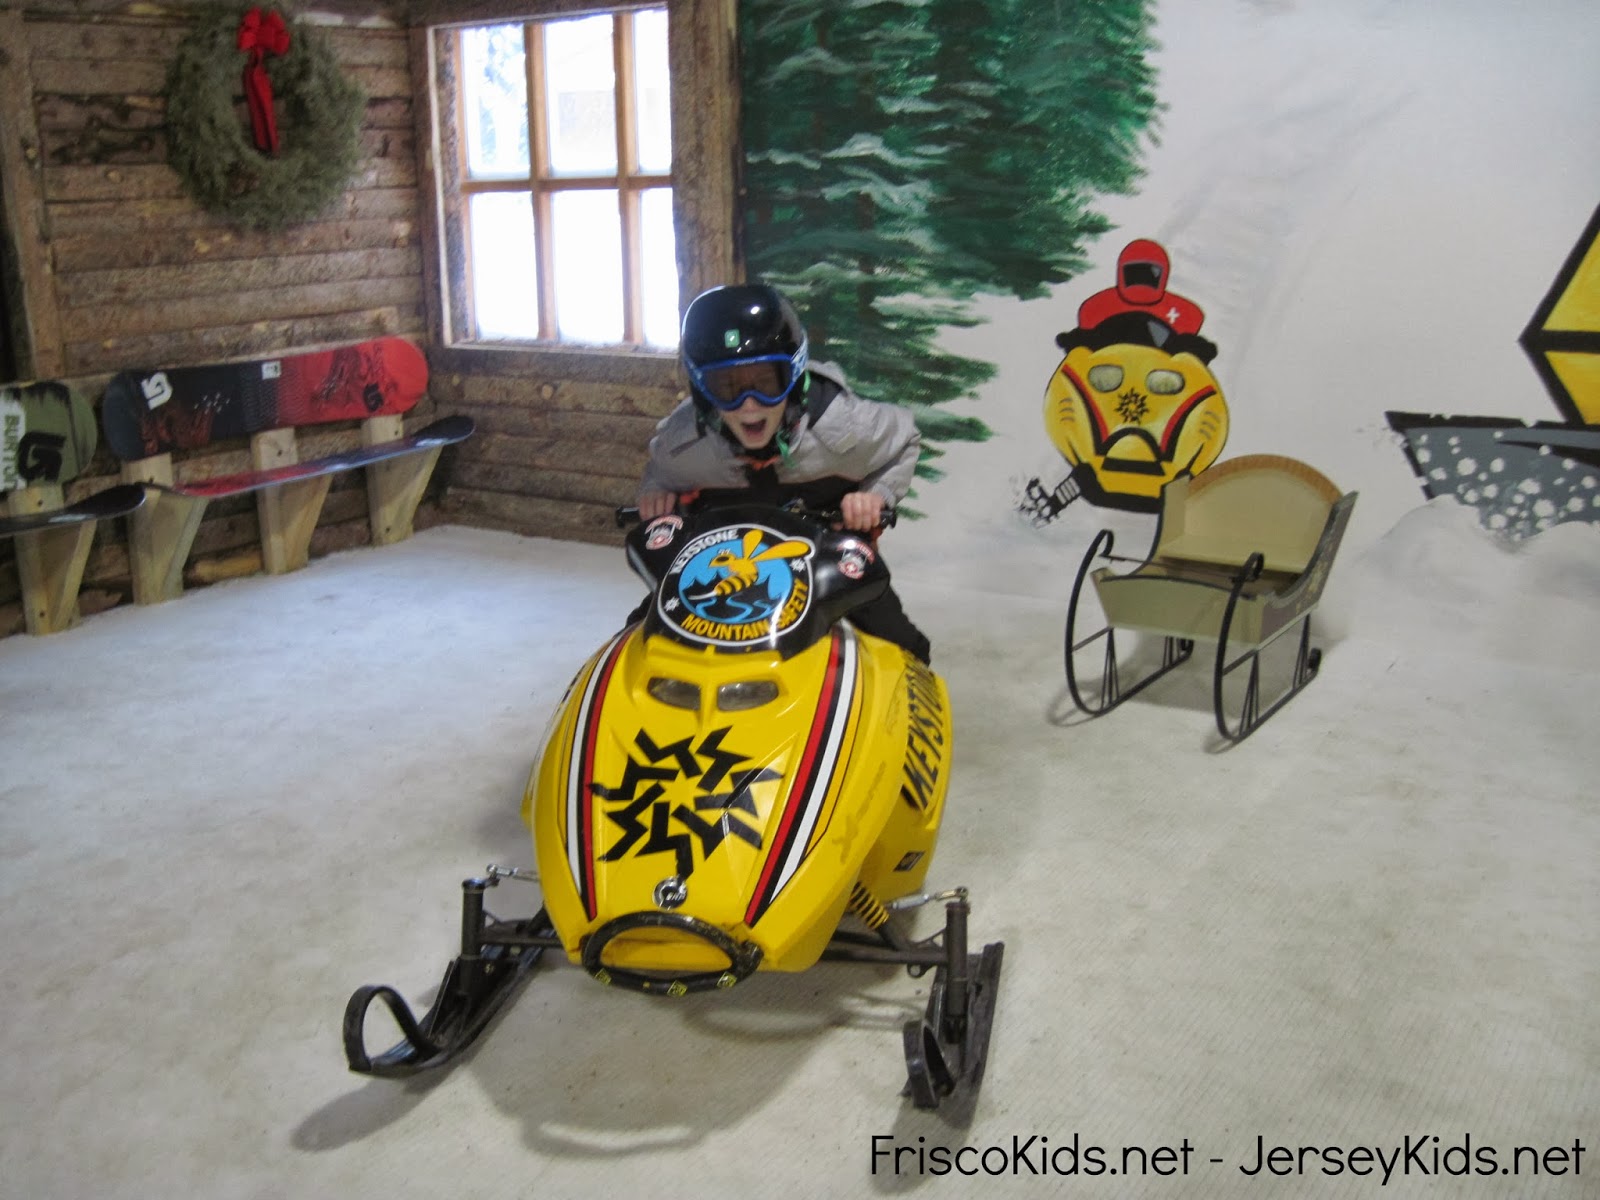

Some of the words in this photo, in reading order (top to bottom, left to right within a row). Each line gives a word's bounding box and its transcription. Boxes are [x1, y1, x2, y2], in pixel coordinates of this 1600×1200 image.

[668, 528, 740, 575] KEYSTONE
[680, 613, 770, 641] MOUNTAIN
[777, 577, 809, 629] SAFETY
